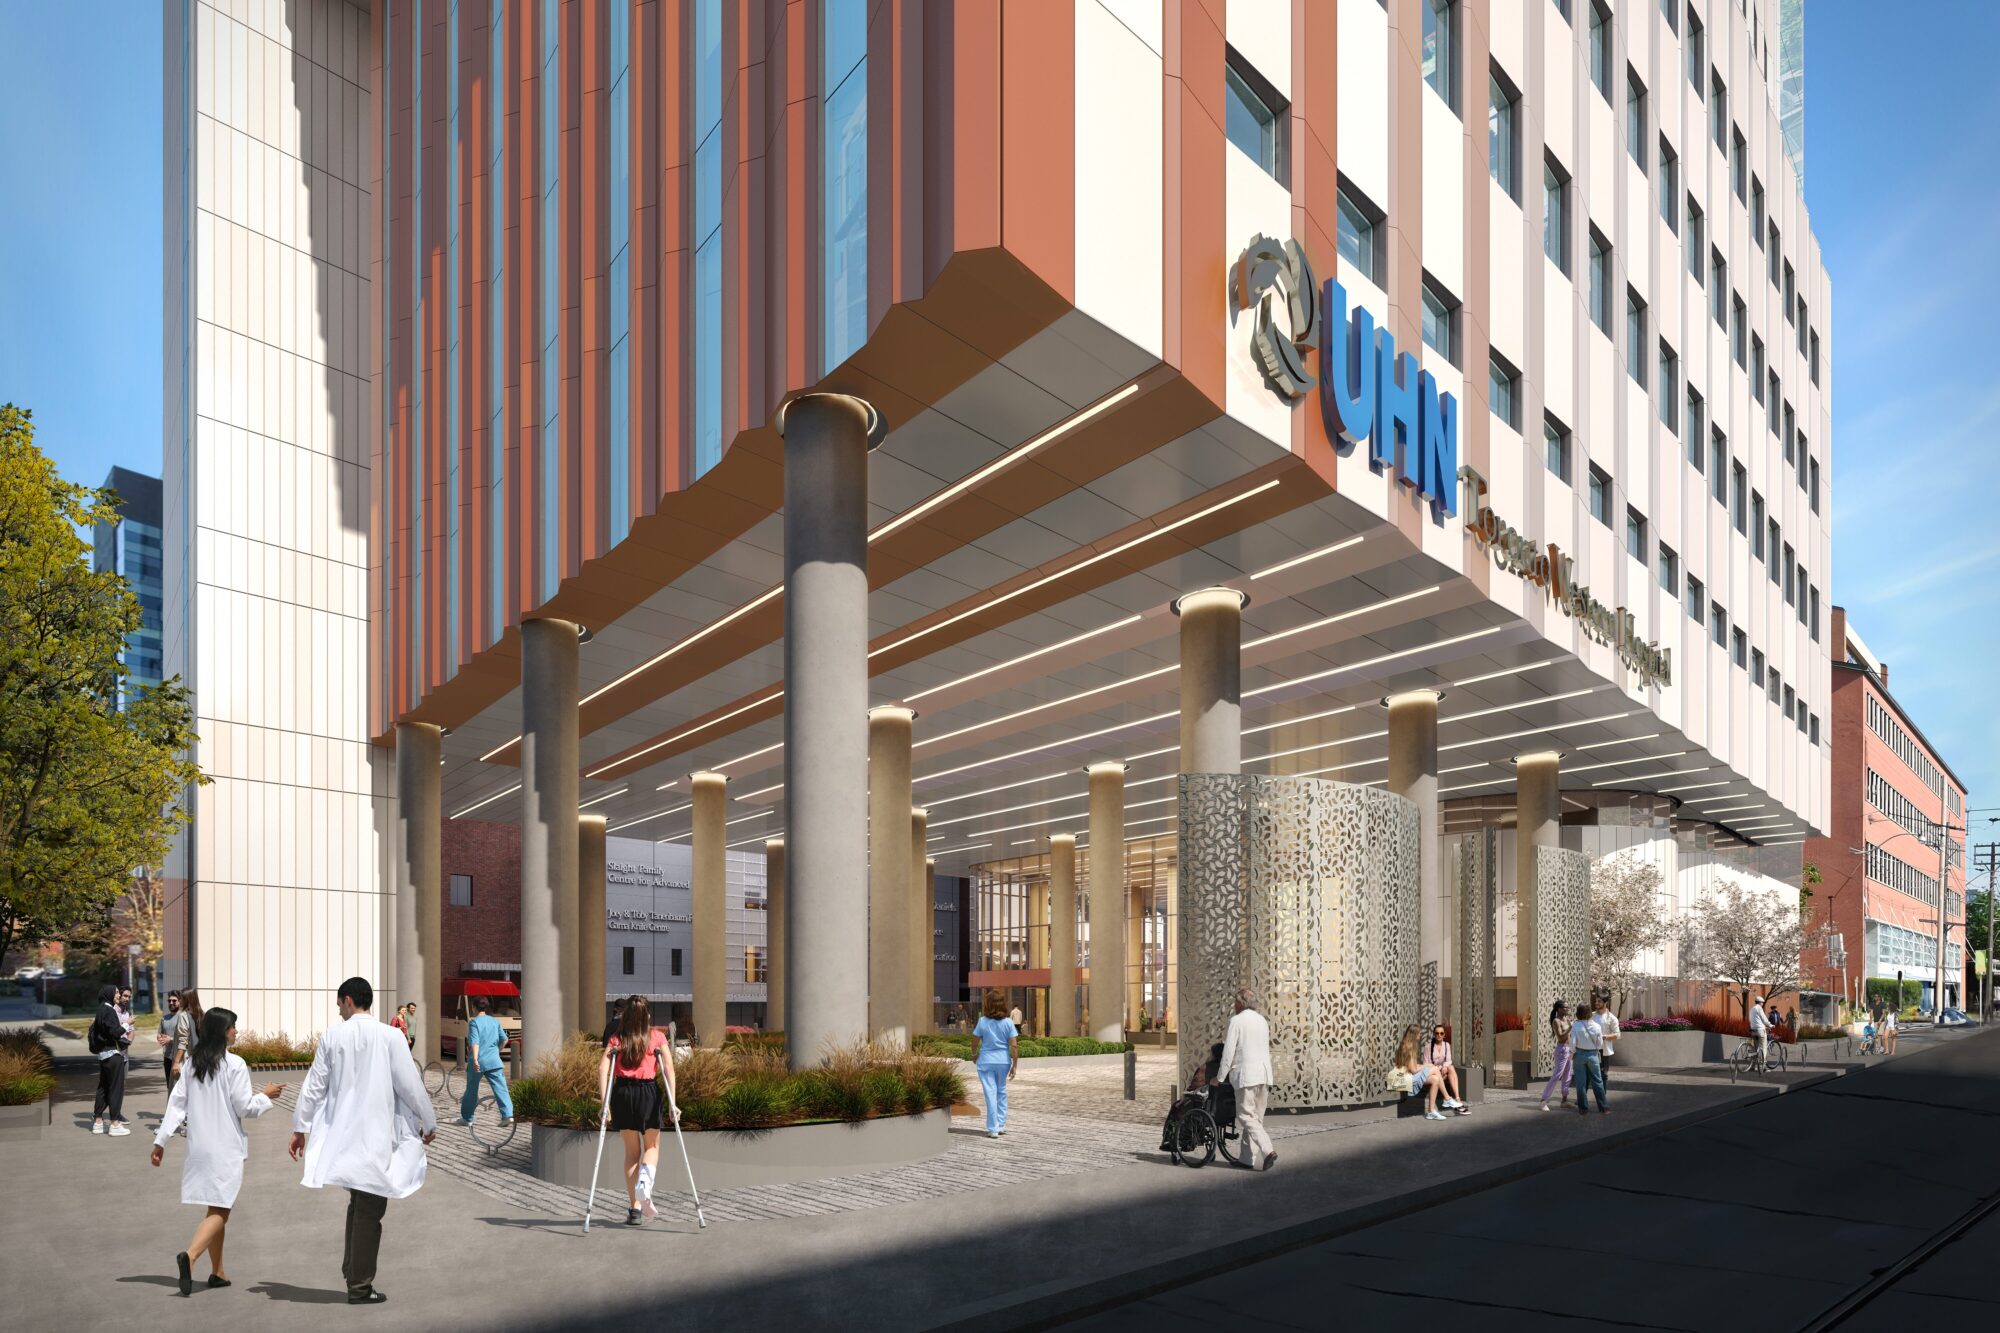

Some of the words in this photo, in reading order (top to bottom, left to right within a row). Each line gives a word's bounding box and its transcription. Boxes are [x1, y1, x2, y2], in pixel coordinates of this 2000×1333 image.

[1322, 277, 1457, 519] UHN
[608, 862, 636, 874] Slaight
[639, 865, 666, 877] Family
[608, 874, 636, 885] Centre
[638, 877, 650, 886] for
[651, 879, 690, 889] Advanced
[608, 909, 622, 920] Joey
[624, 909, 632, 919] &
[633, 910, 649, 922] Toby
[631, 921, 648, 932] Knife
[648, 922, 671, 933] Centre
